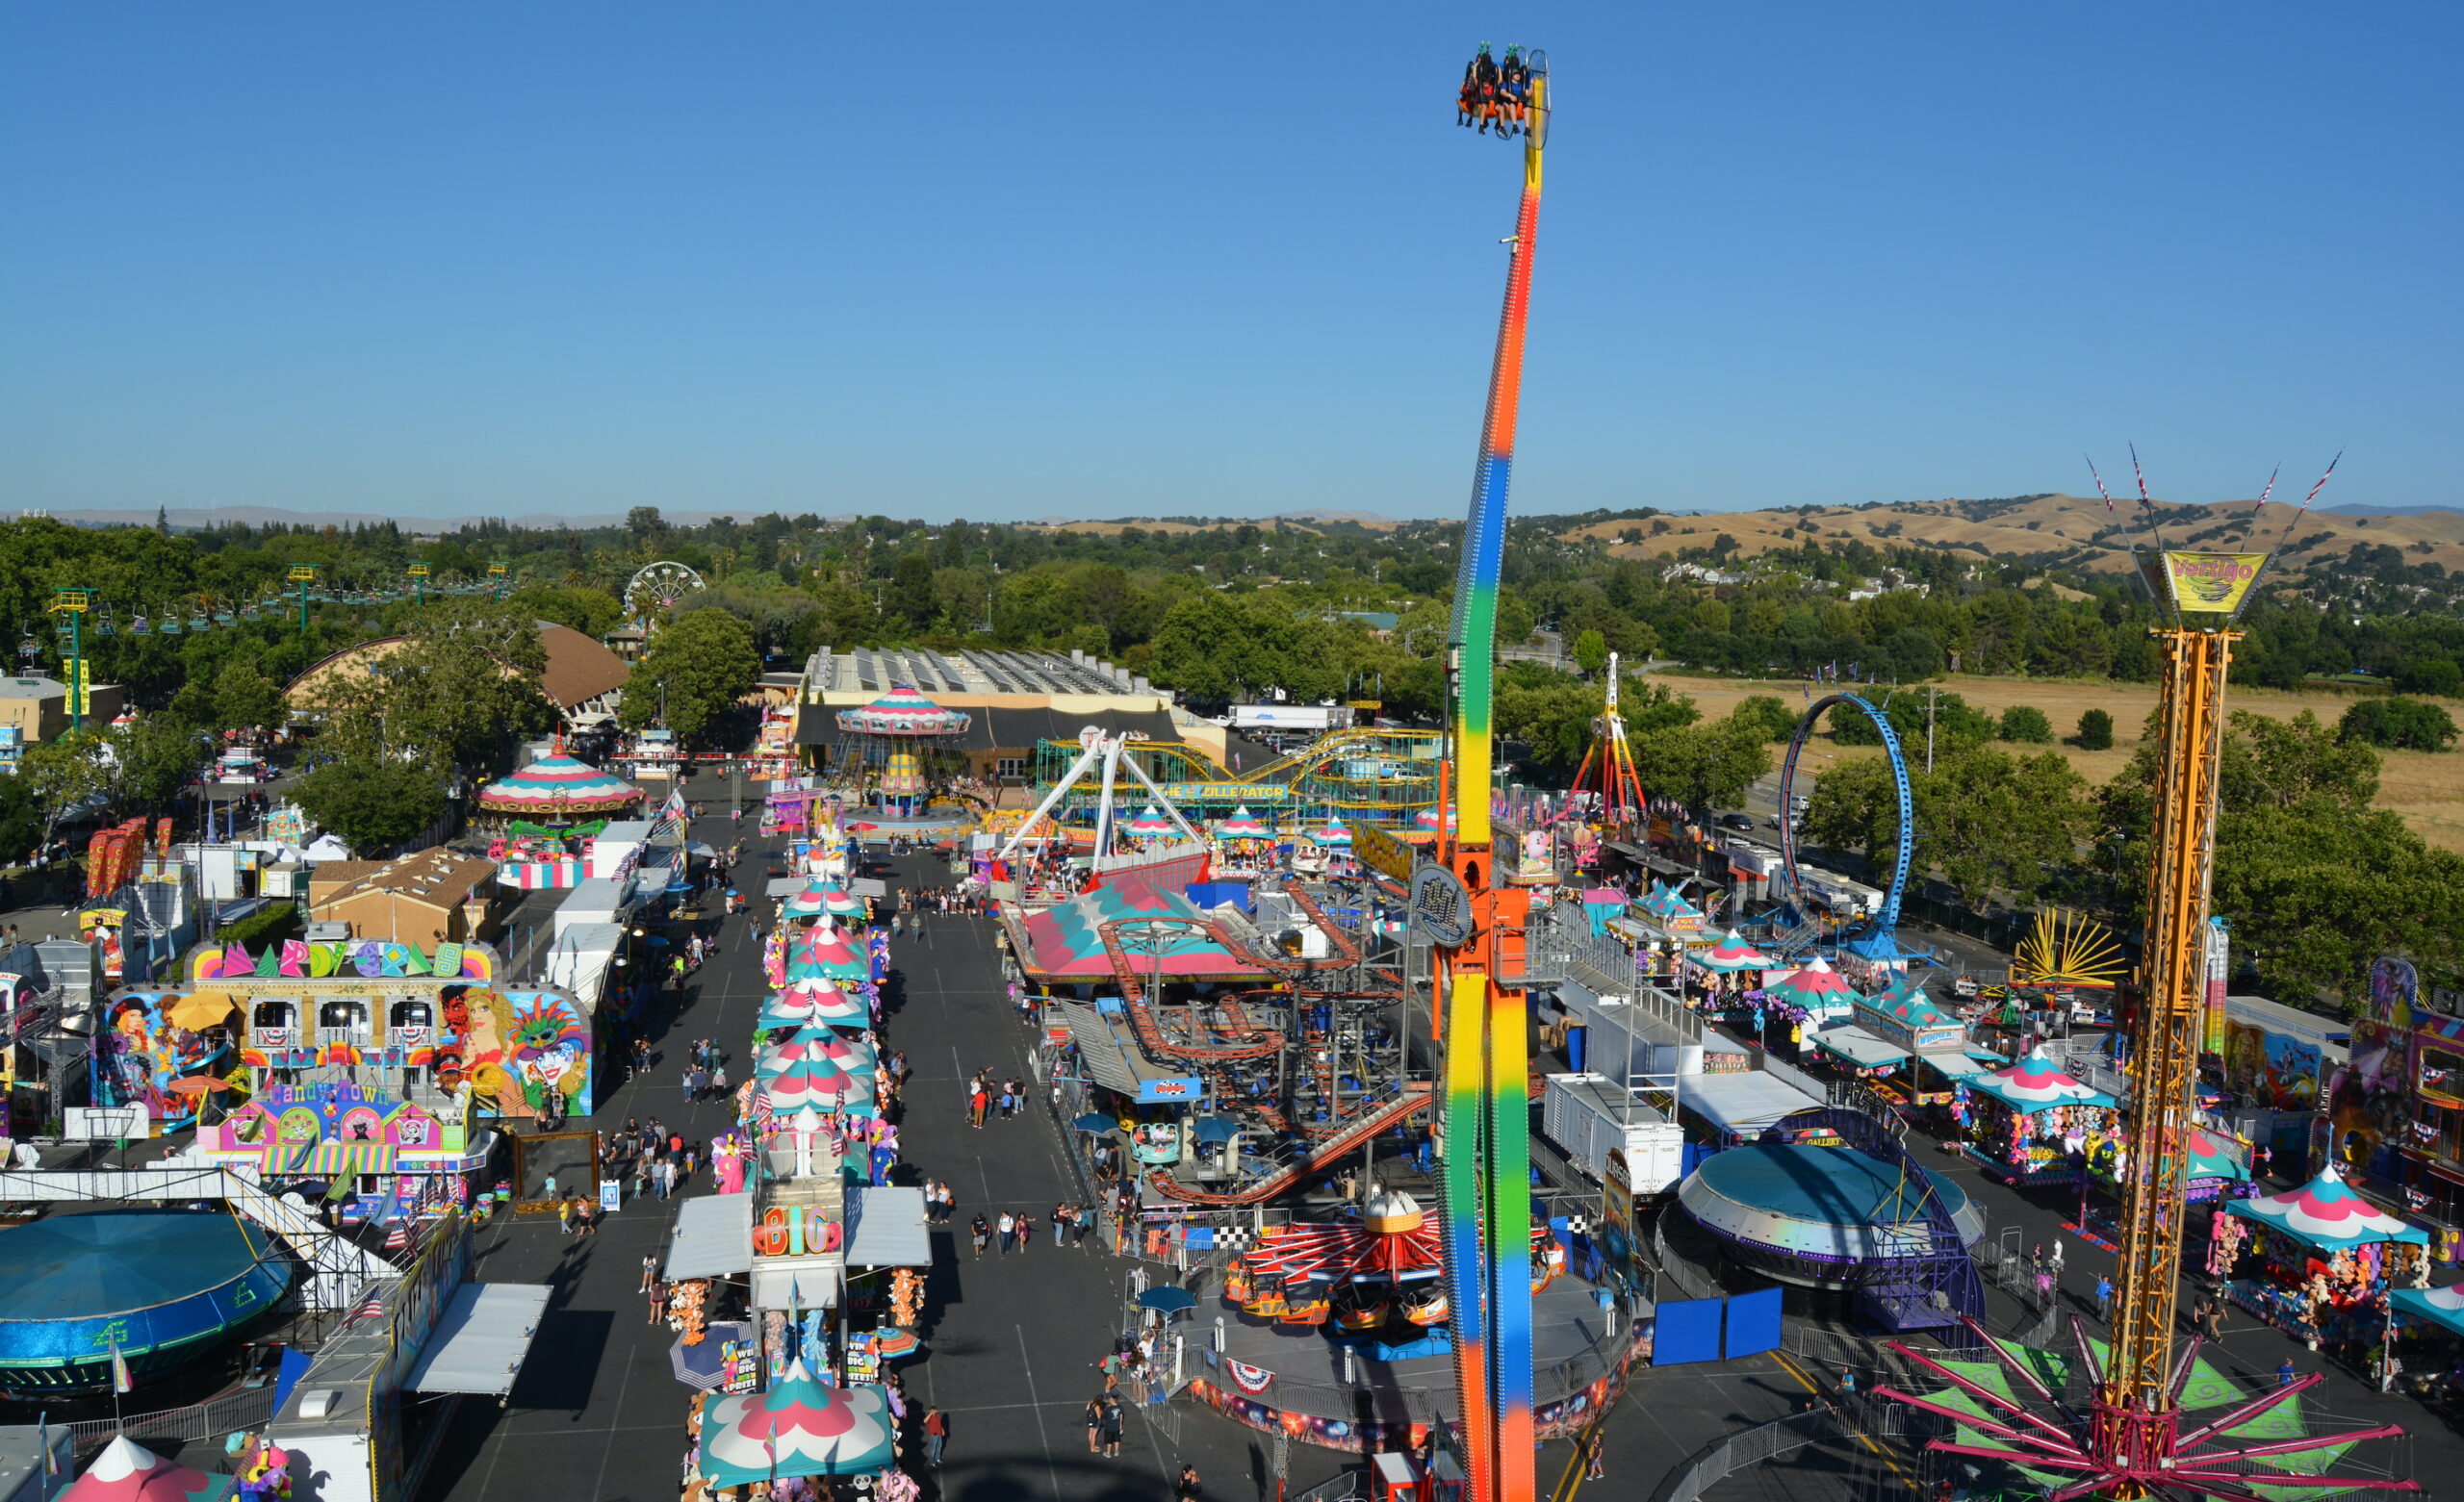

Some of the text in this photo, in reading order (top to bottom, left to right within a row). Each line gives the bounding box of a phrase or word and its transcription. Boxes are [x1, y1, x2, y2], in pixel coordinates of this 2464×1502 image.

[2172, 559, 2253, 582] Vertigo
[1156, 786, 1285, 798] THE ZILLERATOR
[222, 938, 465, 978] MARDI GRAS
[271, 1079, 390, 1107] Candy Town
[1807, 1136, 1841, 1146] GALLERY
[404, 1160, 449, 1170] POPCORN
[1604, 1155, 1631, 1192] QUASAR
[763, 1204, 830, 1257] BIG
[738, 1362, 756, 1375] BIG
